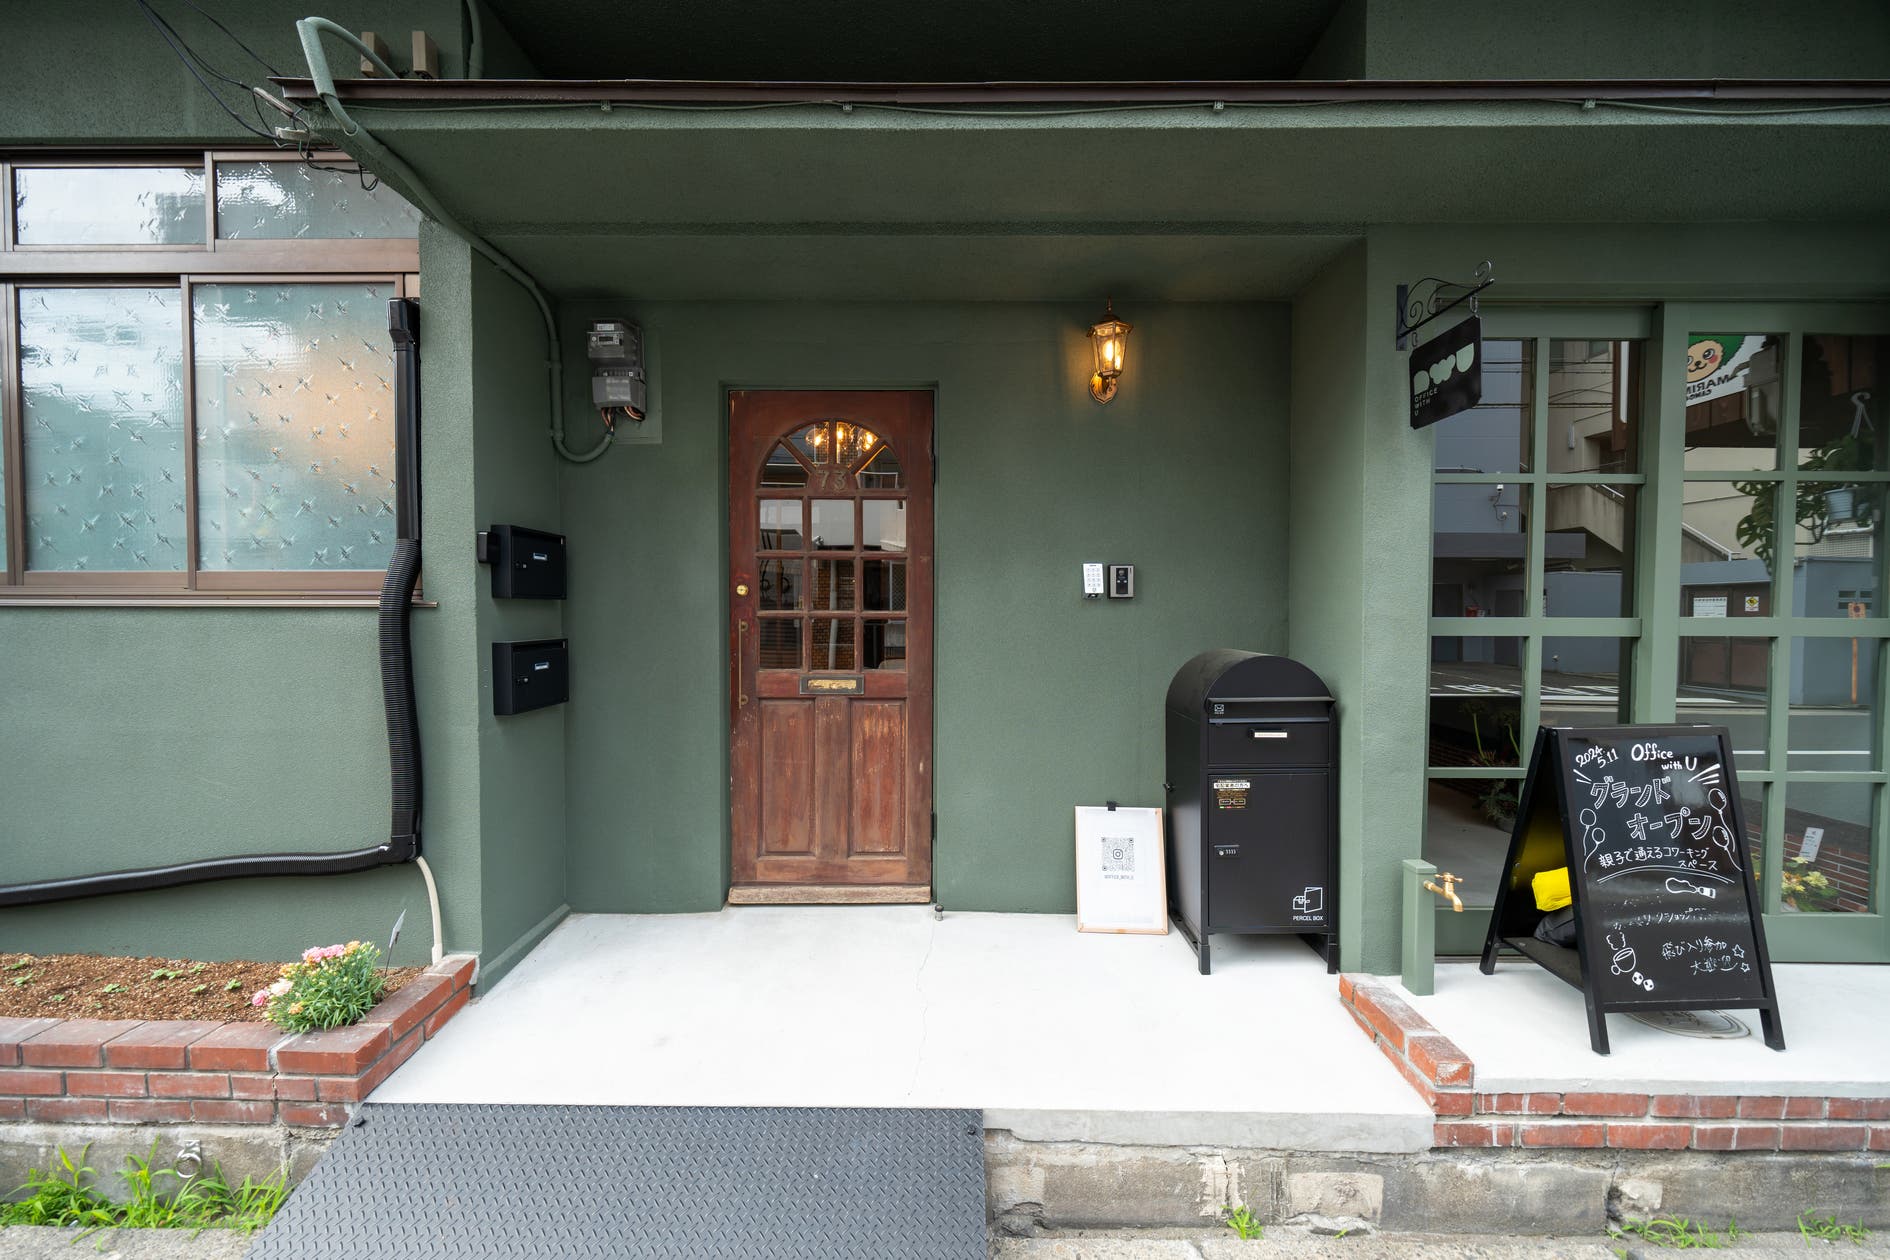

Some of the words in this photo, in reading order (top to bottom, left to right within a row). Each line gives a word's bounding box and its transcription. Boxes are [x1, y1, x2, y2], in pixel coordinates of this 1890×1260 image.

[1414, 387, 1439, 403] OFFICE
[816, 469, 847, 492] 73
[1631, 743, 1674, 762] Office
[1661, 761, 1683, 770] with
[1685, 756, 1698, 771] U
[1590, 776, 1671, 809] グランド
[1627, 806, 1712, 840] オープン
[1598, 846, 1709, 869] 親子で通えるコワーキング
[1678, 860, 1718, 871] スペース
